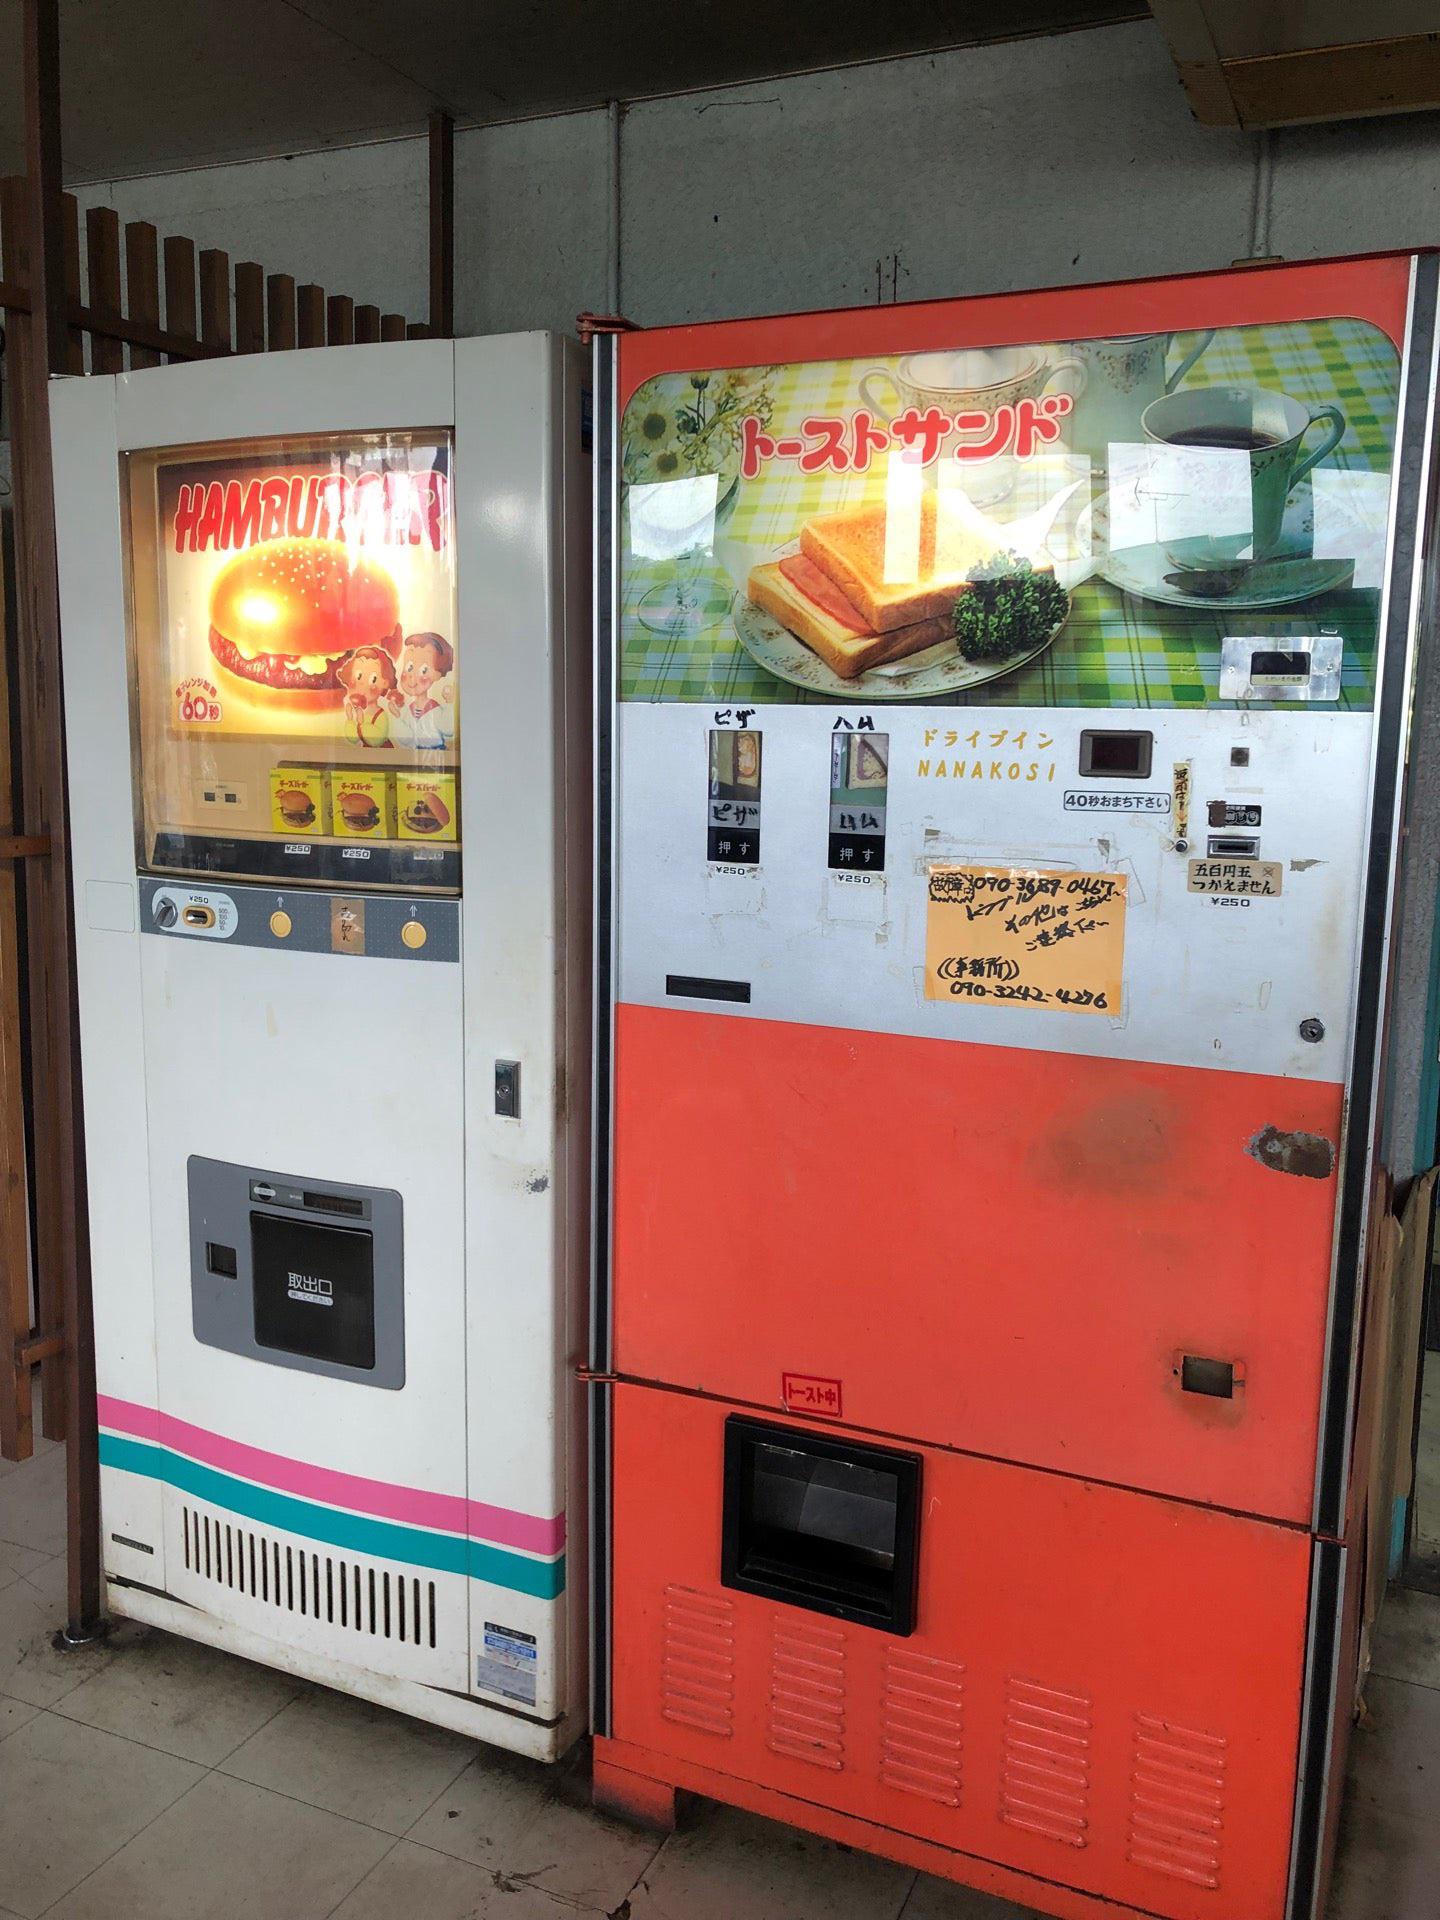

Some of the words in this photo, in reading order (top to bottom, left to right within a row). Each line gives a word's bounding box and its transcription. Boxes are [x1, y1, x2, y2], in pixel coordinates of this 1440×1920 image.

[741, 393, 1074, 480] トーストサンド
[714, 709, 756, 728] ピザ
[833, 716, 875, 730] ハム
[918, 759, 1056, 782] NANAKOSI
[1065, 794, 1169, 809] 40秒おまち下さい
[713, 803, 758, 825] ピザ
[285, 844, 311, 853] ¥250
[342, 849, 370, 859] ¥250
[718, 841, 751, 854] 押す
[839, 848, 874, 862] 押す
[716, 866, 745, 876] ¥250
[1194, 864, 1252, 878] 五百円玉
[837, 874, 871, 884] ¥250
[1192, 879, 1276, 895] つかえません
[189, 895, 209, 904] ¥250
[1211, 897, 1250, 908] ¥250
[288, 1271, 333, 1295] 取出口
[788, 1382, 836, 1406] トースト中
